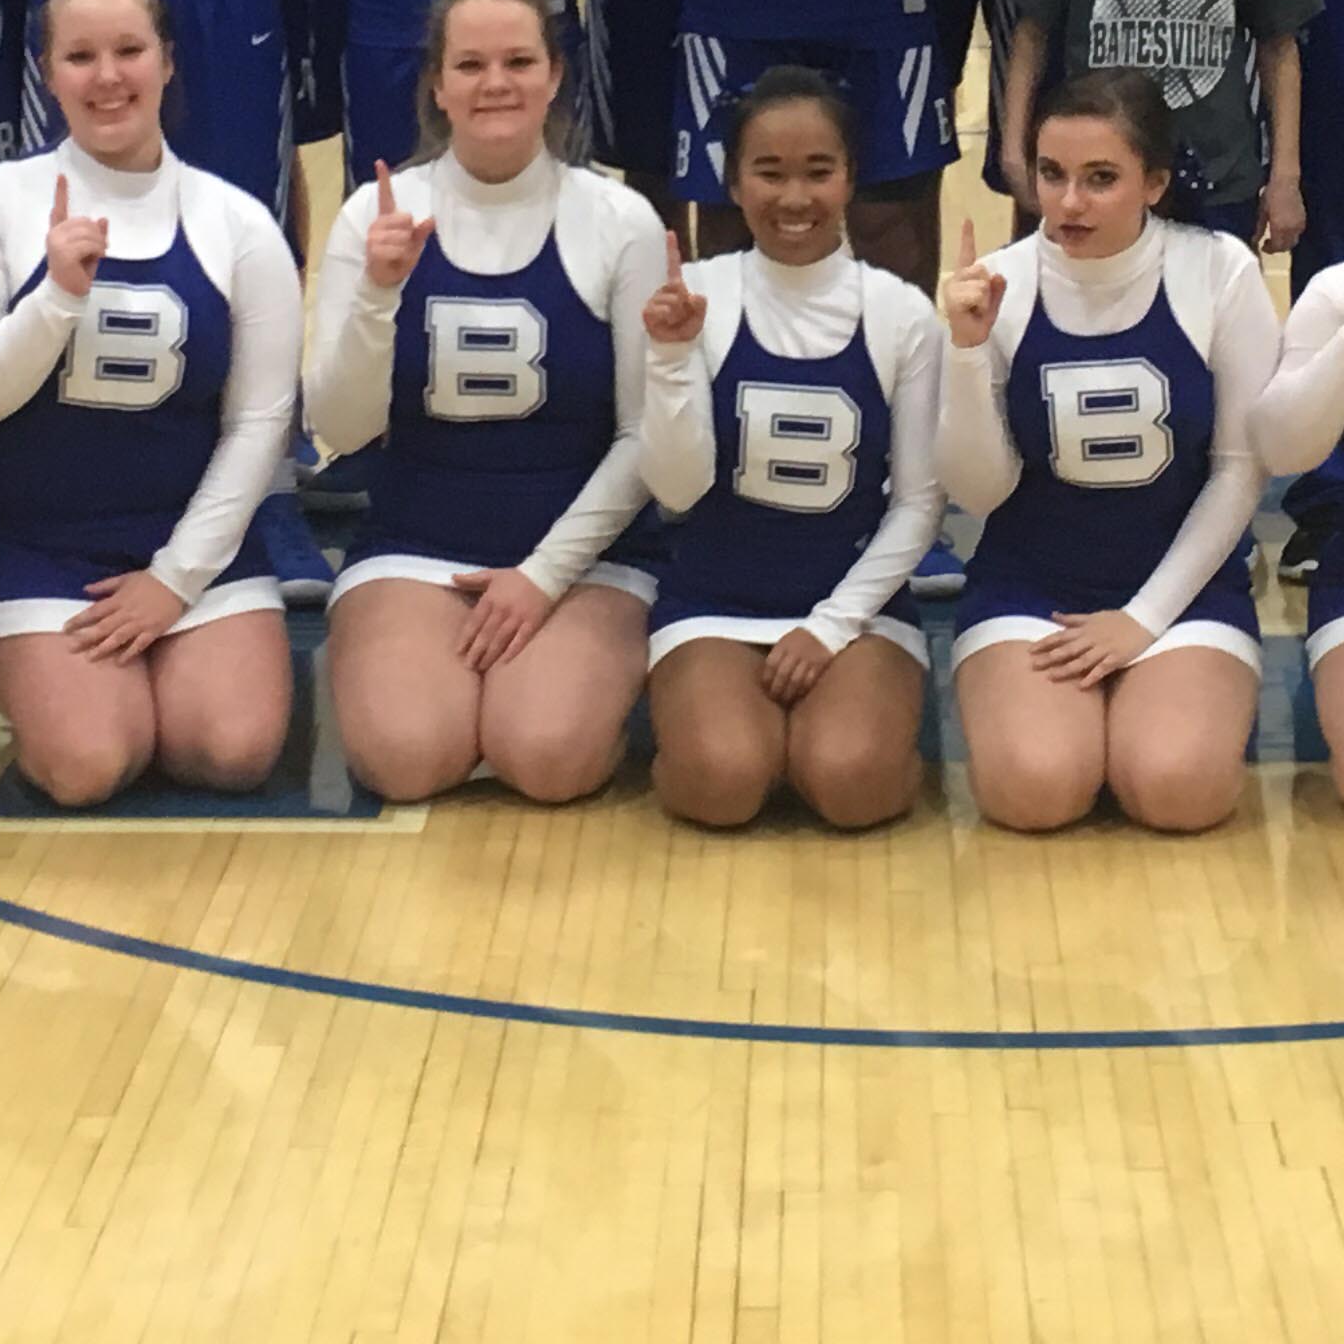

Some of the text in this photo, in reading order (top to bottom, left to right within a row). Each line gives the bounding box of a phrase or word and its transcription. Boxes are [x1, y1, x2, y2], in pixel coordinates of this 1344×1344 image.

[57, 281, 188, 410] B
[424, 296, 548, 422] B
[733, 381, 861, 513] B
[1040, 357, 1174, 489] B
